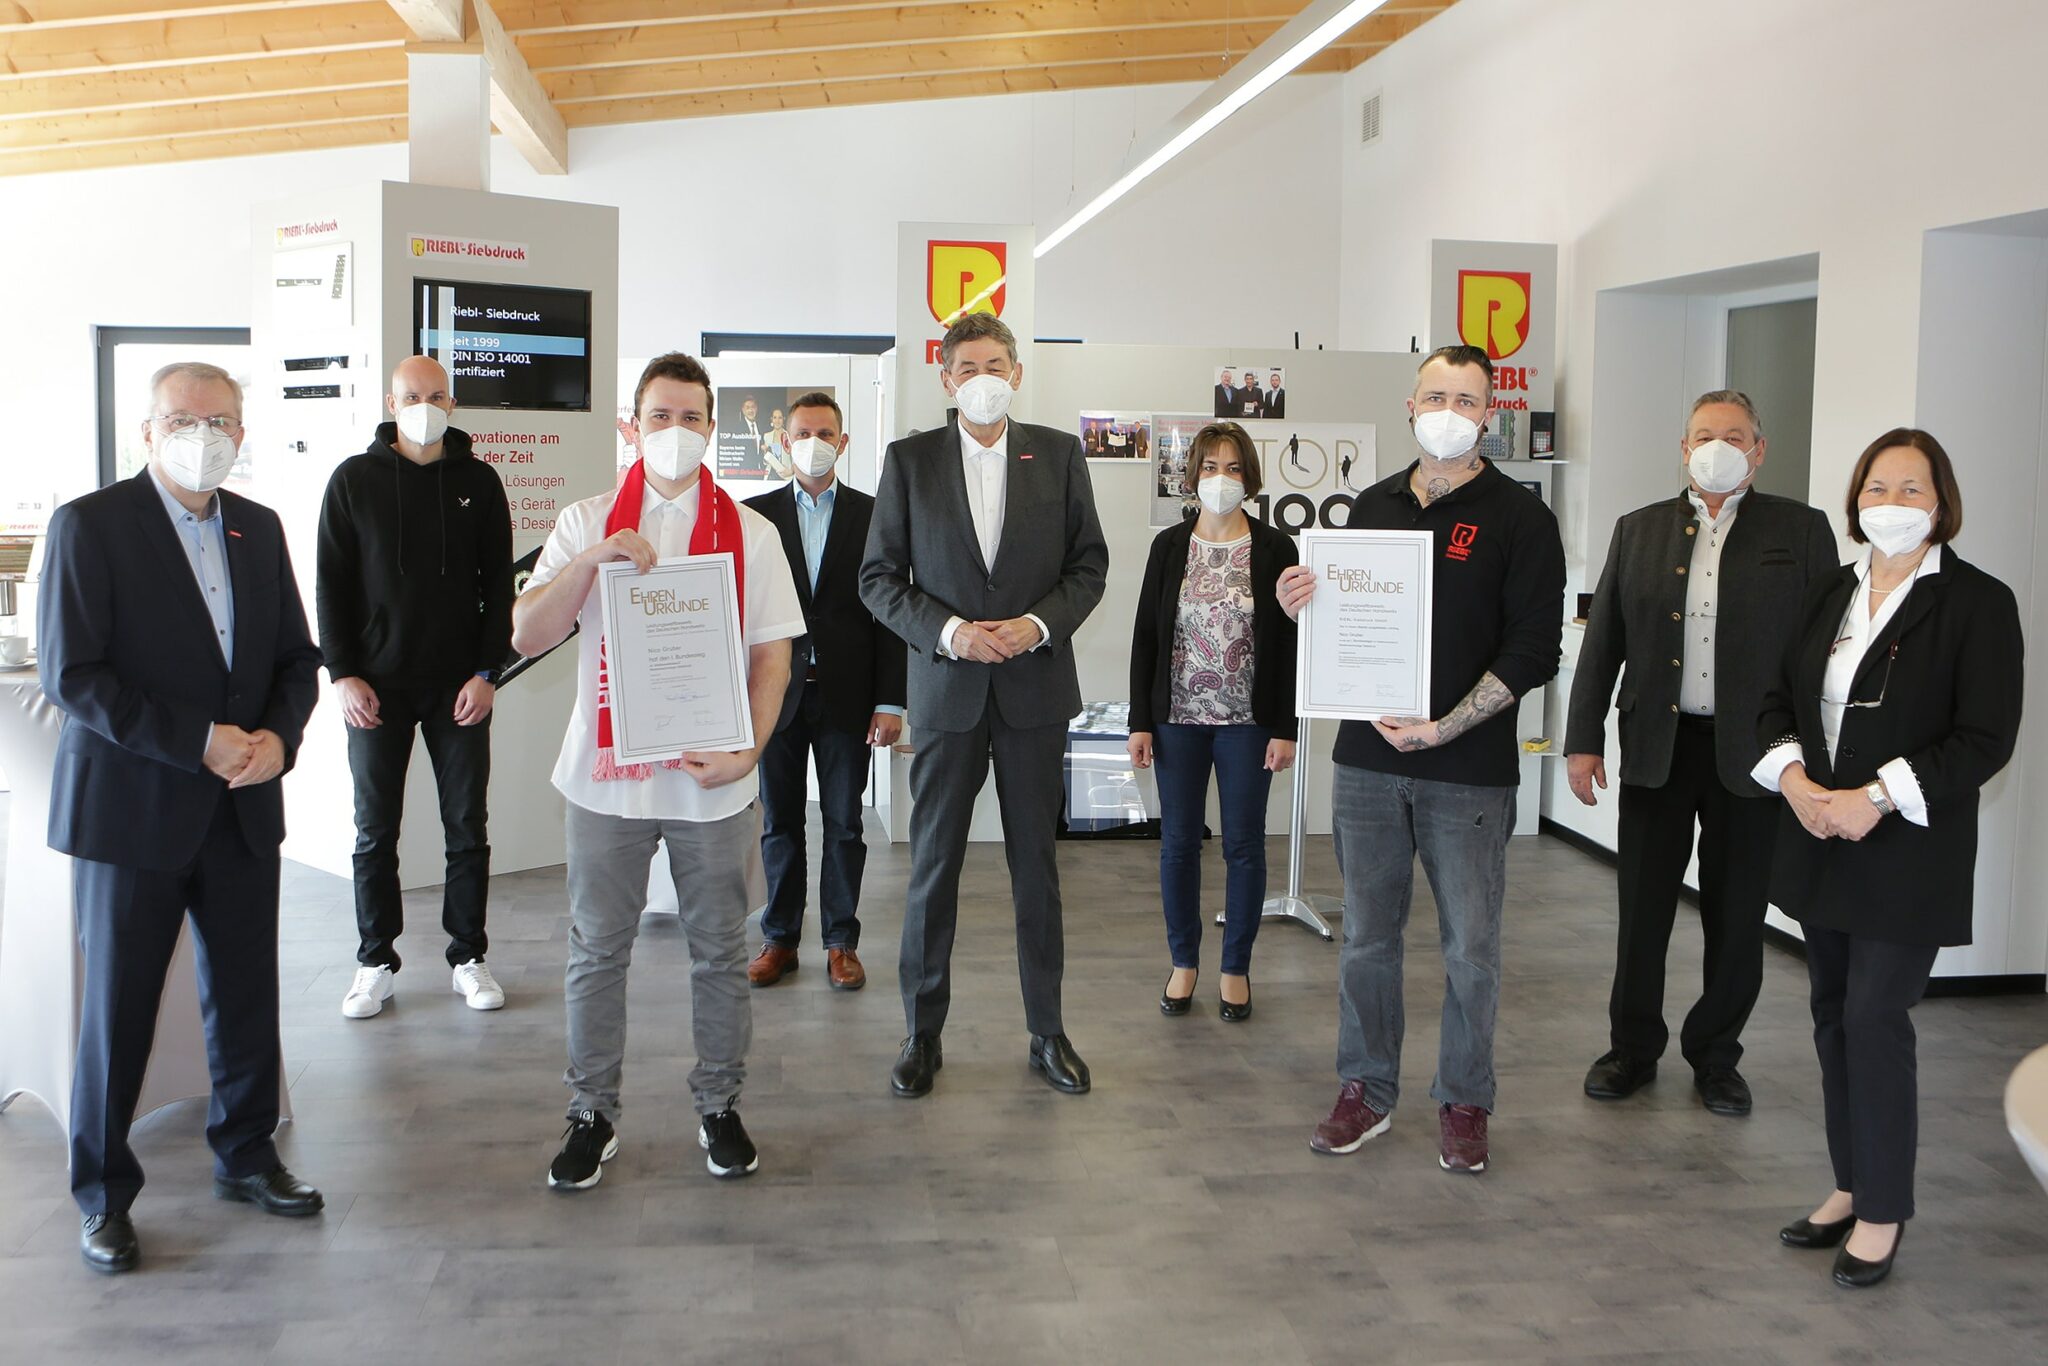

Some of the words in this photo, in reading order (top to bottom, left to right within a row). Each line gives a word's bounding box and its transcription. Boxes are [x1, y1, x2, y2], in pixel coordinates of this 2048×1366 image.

[486, 308, 541, 321] Siebdruck
[473, 337, 500, 348] 1999
[450, 351, 472, 361] DIN
[475, 352, 495, 362] ISO
[498, 353, 531, 364] 14001
[450, 366, 505, 377] zertifiziert
[471, 431, 536, 444] ovationen
[540, 434, 560, 445] am
[484, 450, 505, 463] der
[509, 450, 534, 463] Zeit
[505, 474, 565, 490] Lösungen
[521, 497, 556, 510] Gerät
[521, 517, 556, 532] Desig
[1327, 564, 1371, 581] EHREN
[1340, 575, 1404, 594] URKUNDE
[630, 587, 676, 604] EHREN
[644, 598, 710, 616] URKUNDE
